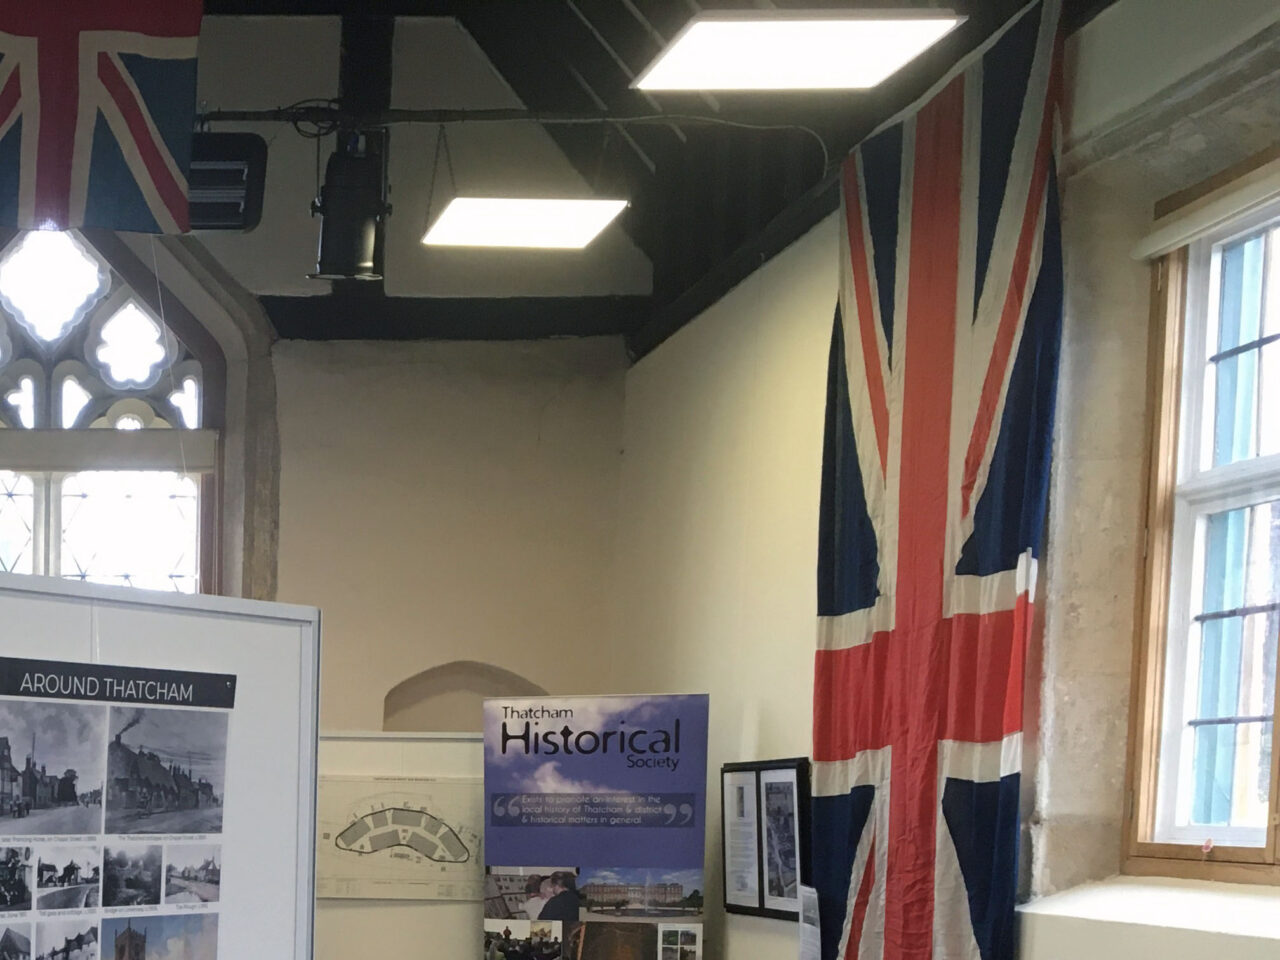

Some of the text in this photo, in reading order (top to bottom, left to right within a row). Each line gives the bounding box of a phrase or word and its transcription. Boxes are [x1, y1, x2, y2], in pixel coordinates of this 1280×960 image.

[20, 672, 193, 702] AROUND THATCHAM
[502, 705, 574, 719] Thatcham
[501, 718, 680, 755] Historical
[626, 754, 679, 772] Society
